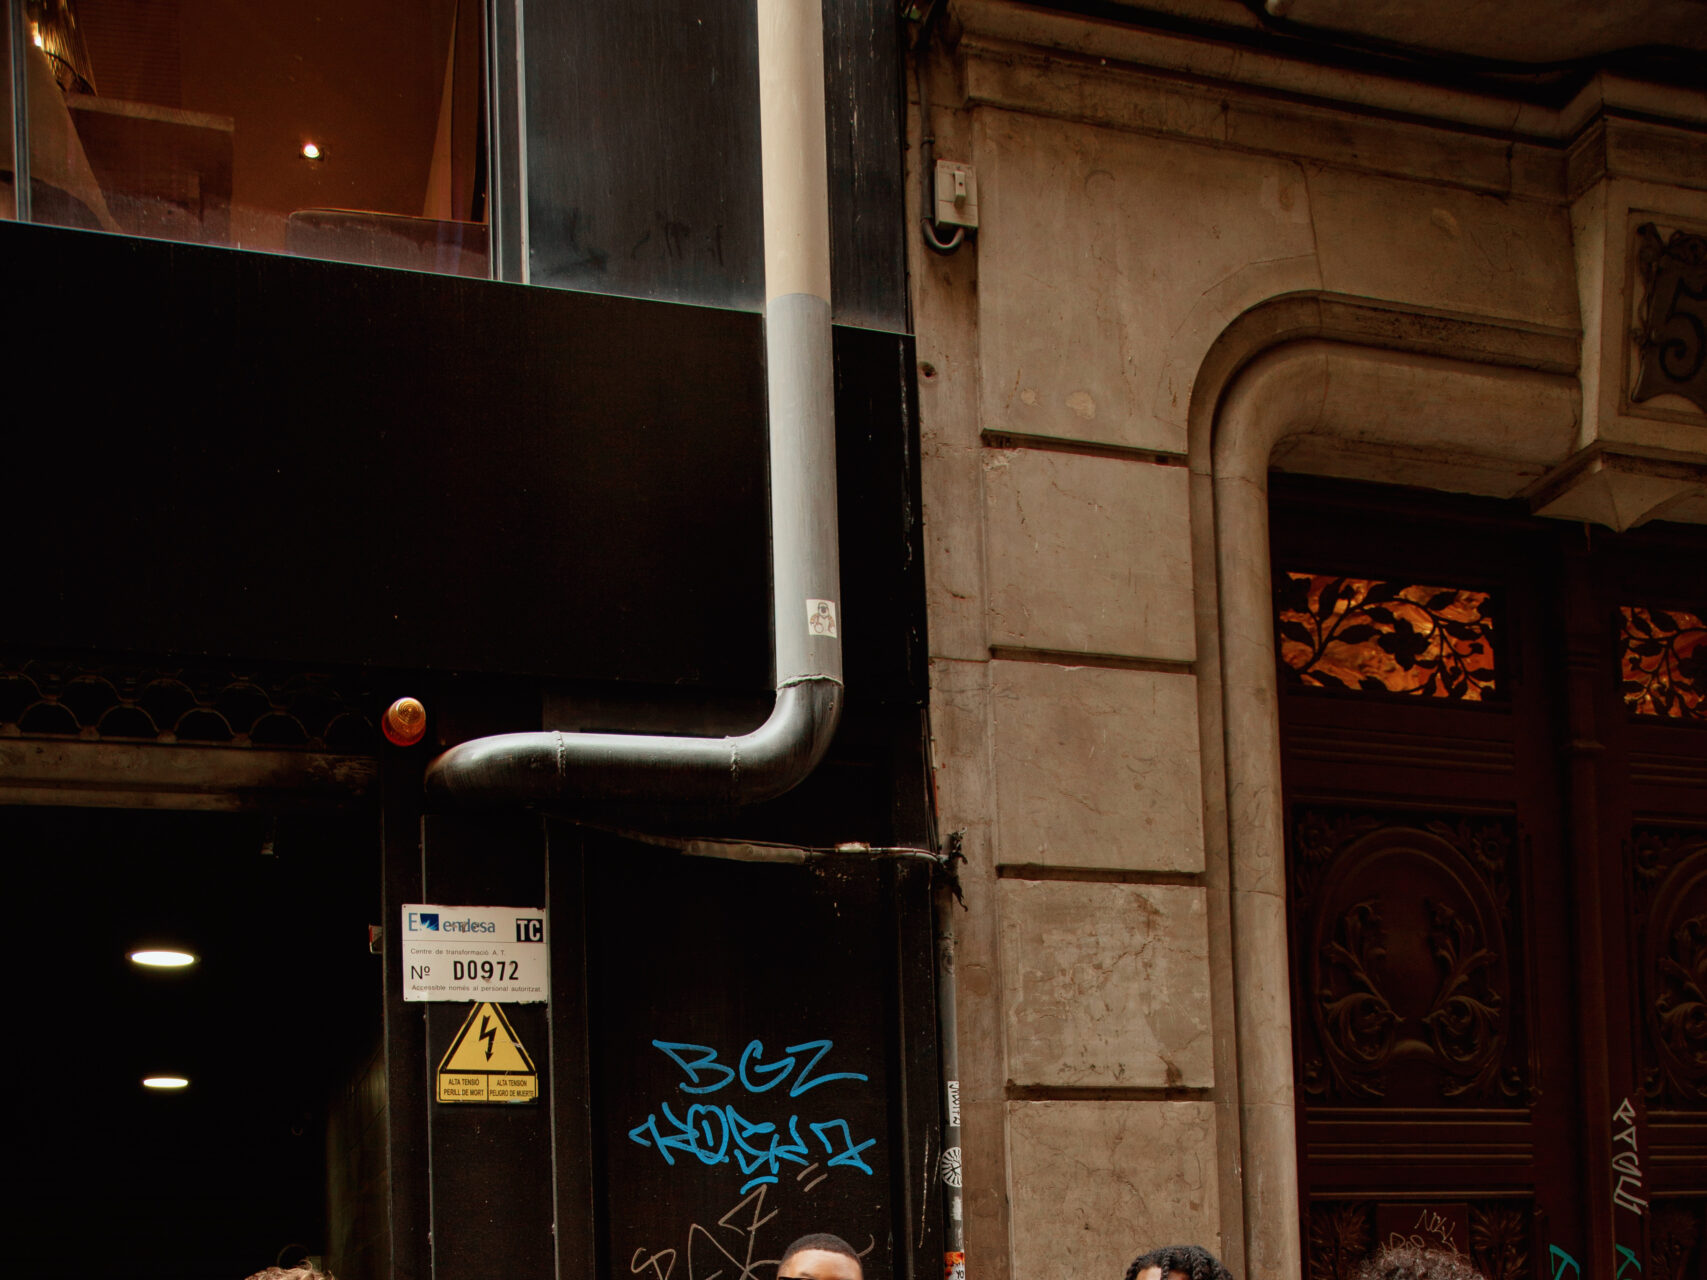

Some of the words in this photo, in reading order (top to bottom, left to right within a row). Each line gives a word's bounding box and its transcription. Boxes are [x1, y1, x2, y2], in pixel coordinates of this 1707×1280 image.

[442, 918, 496, 933] endesa
[517, 920, 541, 941] TC
[411, 984, 446, 992] Accessible
[448, 1078, 461, 1086] ALTA
[496, 1079, 508, 1087] ALTA
[443, 1088, 460, 1096] PERILL
[489, 1089, 508, 1097] PELIGRO
[509, 1089, 516, 1097] DE
